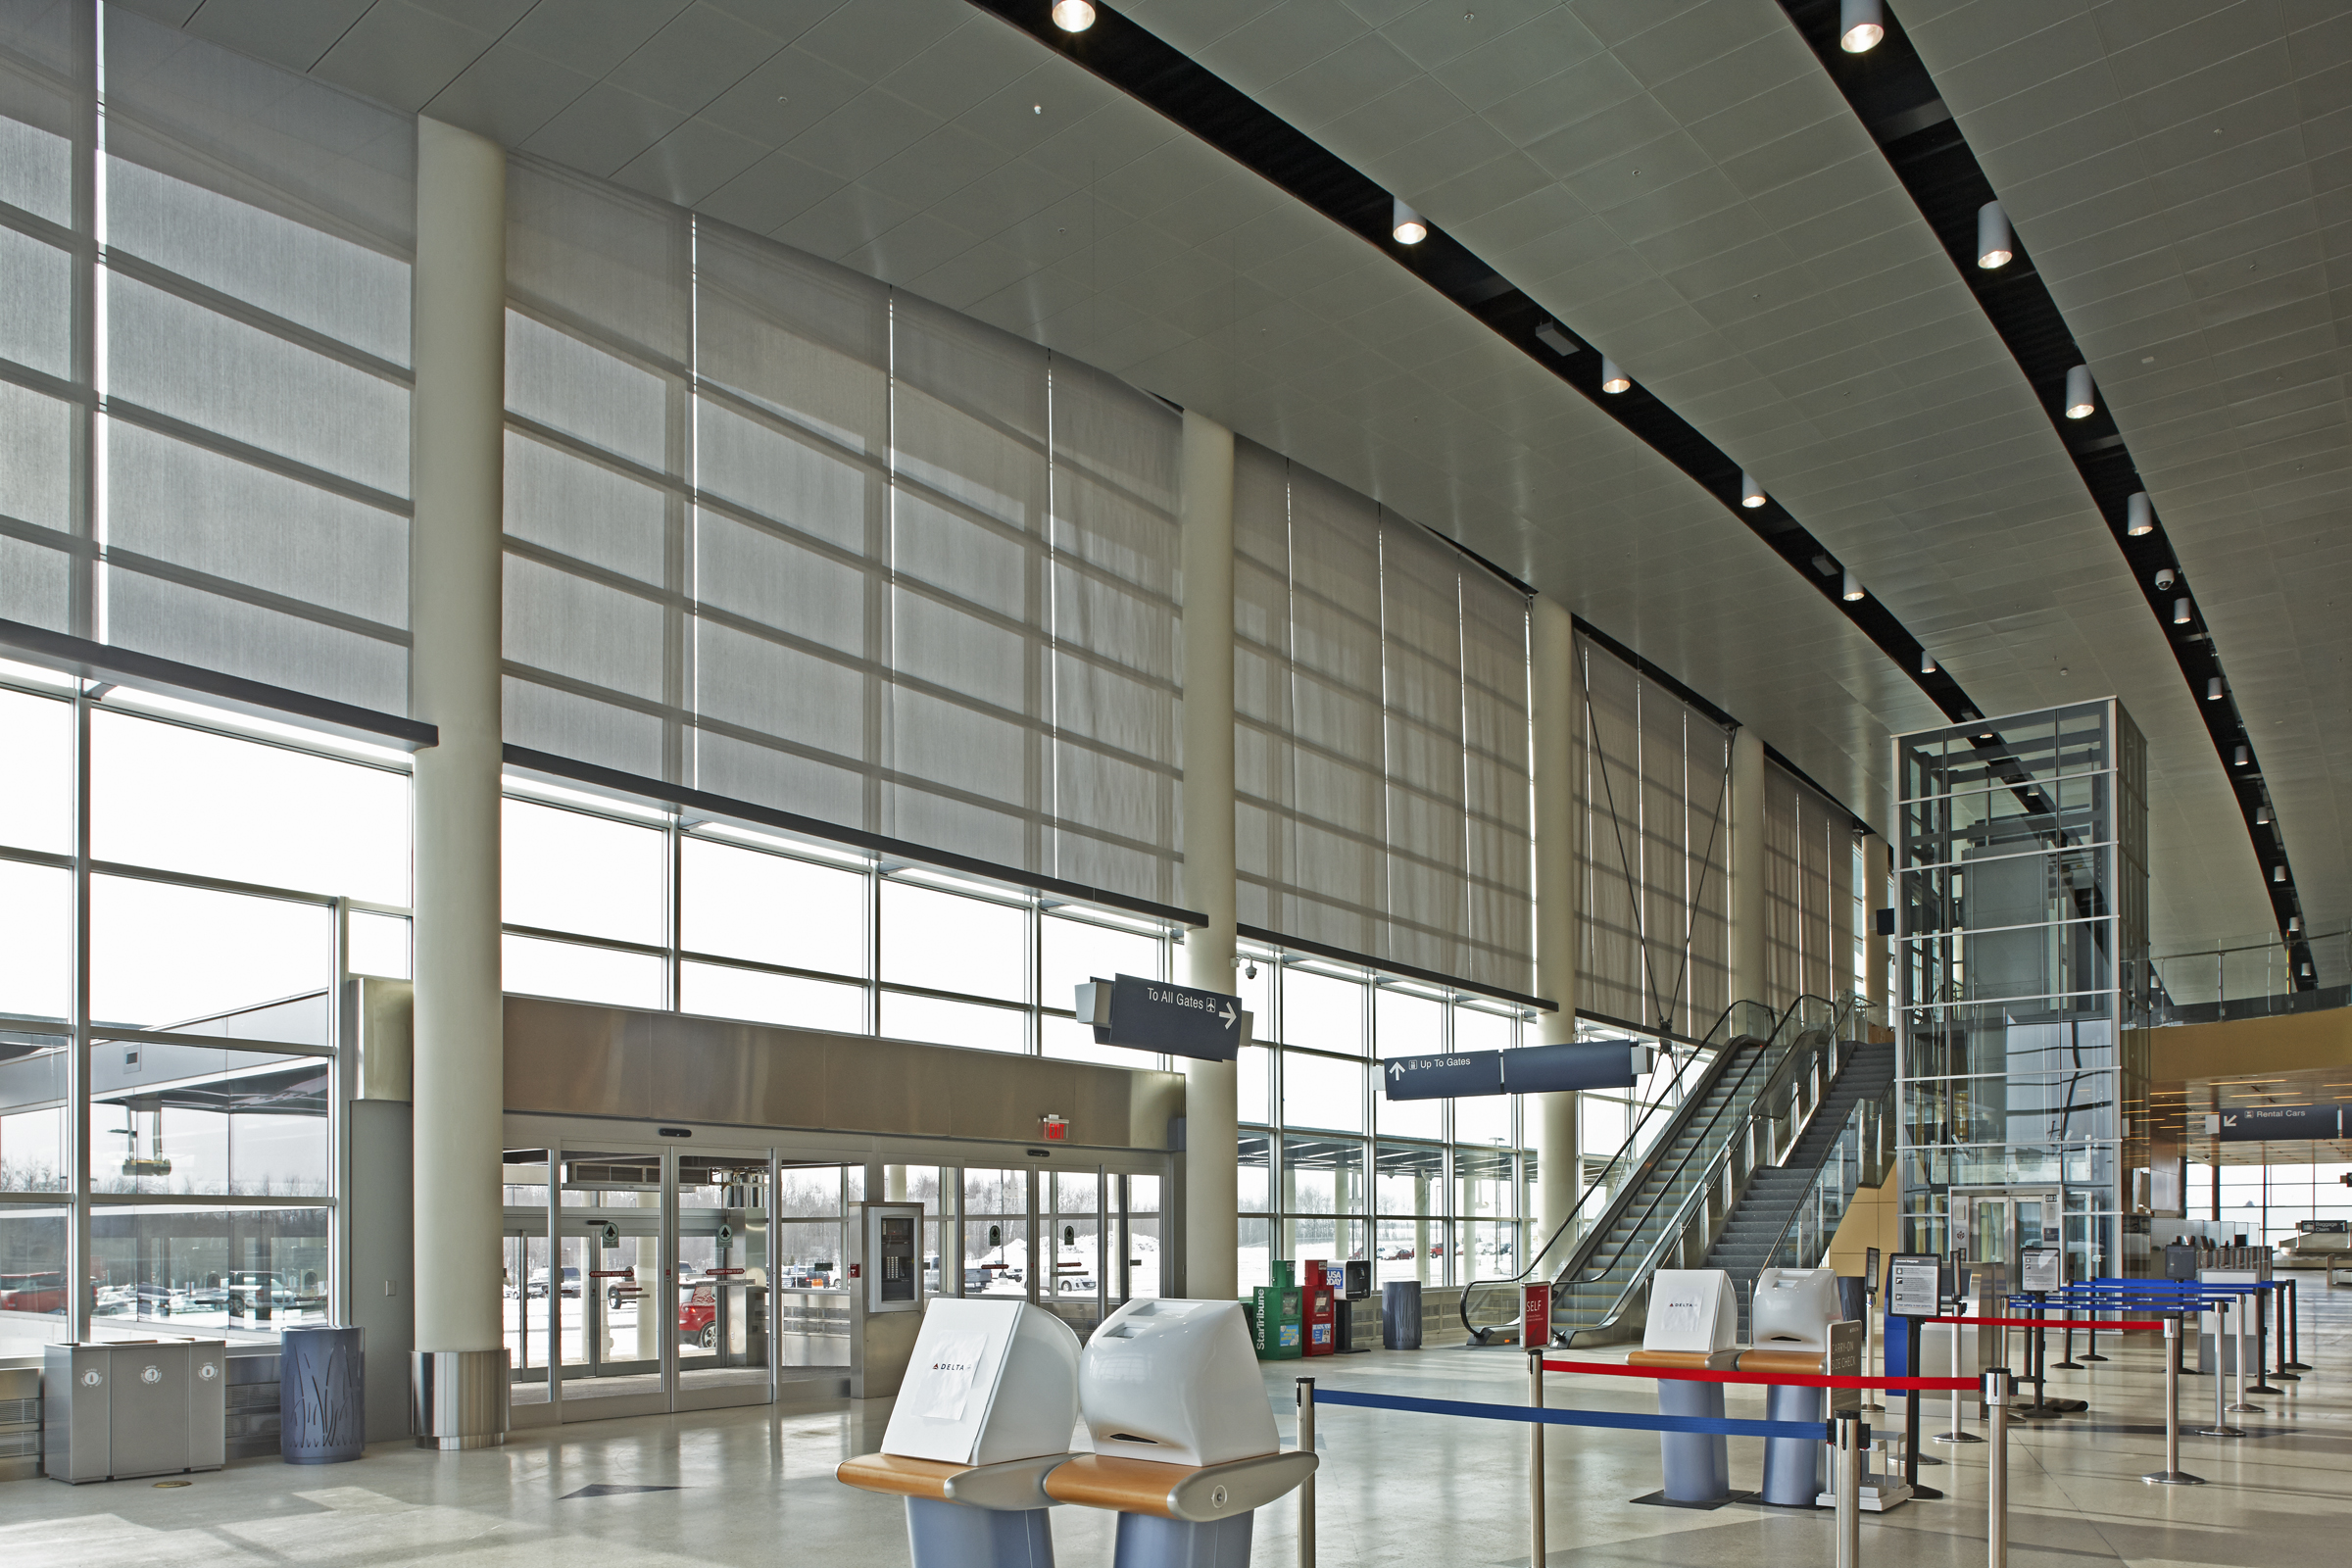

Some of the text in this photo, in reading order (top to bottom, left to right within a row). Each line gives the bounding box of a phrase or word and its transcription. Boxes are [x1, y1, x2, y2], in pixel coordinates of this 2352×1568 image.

[1147, 987, 1203, 1009] To All Gates
[1420, 1057, 1471, 1070] Up To Gates
[1049, 1123, 1065, 1140] EXIT
[2340, 1221, 2346, 1232] 1
[1526, 1299, 1543, 1312] SELF
[1256, 1289, 1265, 1350] StarTribune
[1832, 1341, 1854, 1354] CARRY-ON
[1832, 1355, 1857, 1370] SIZE CHECK
